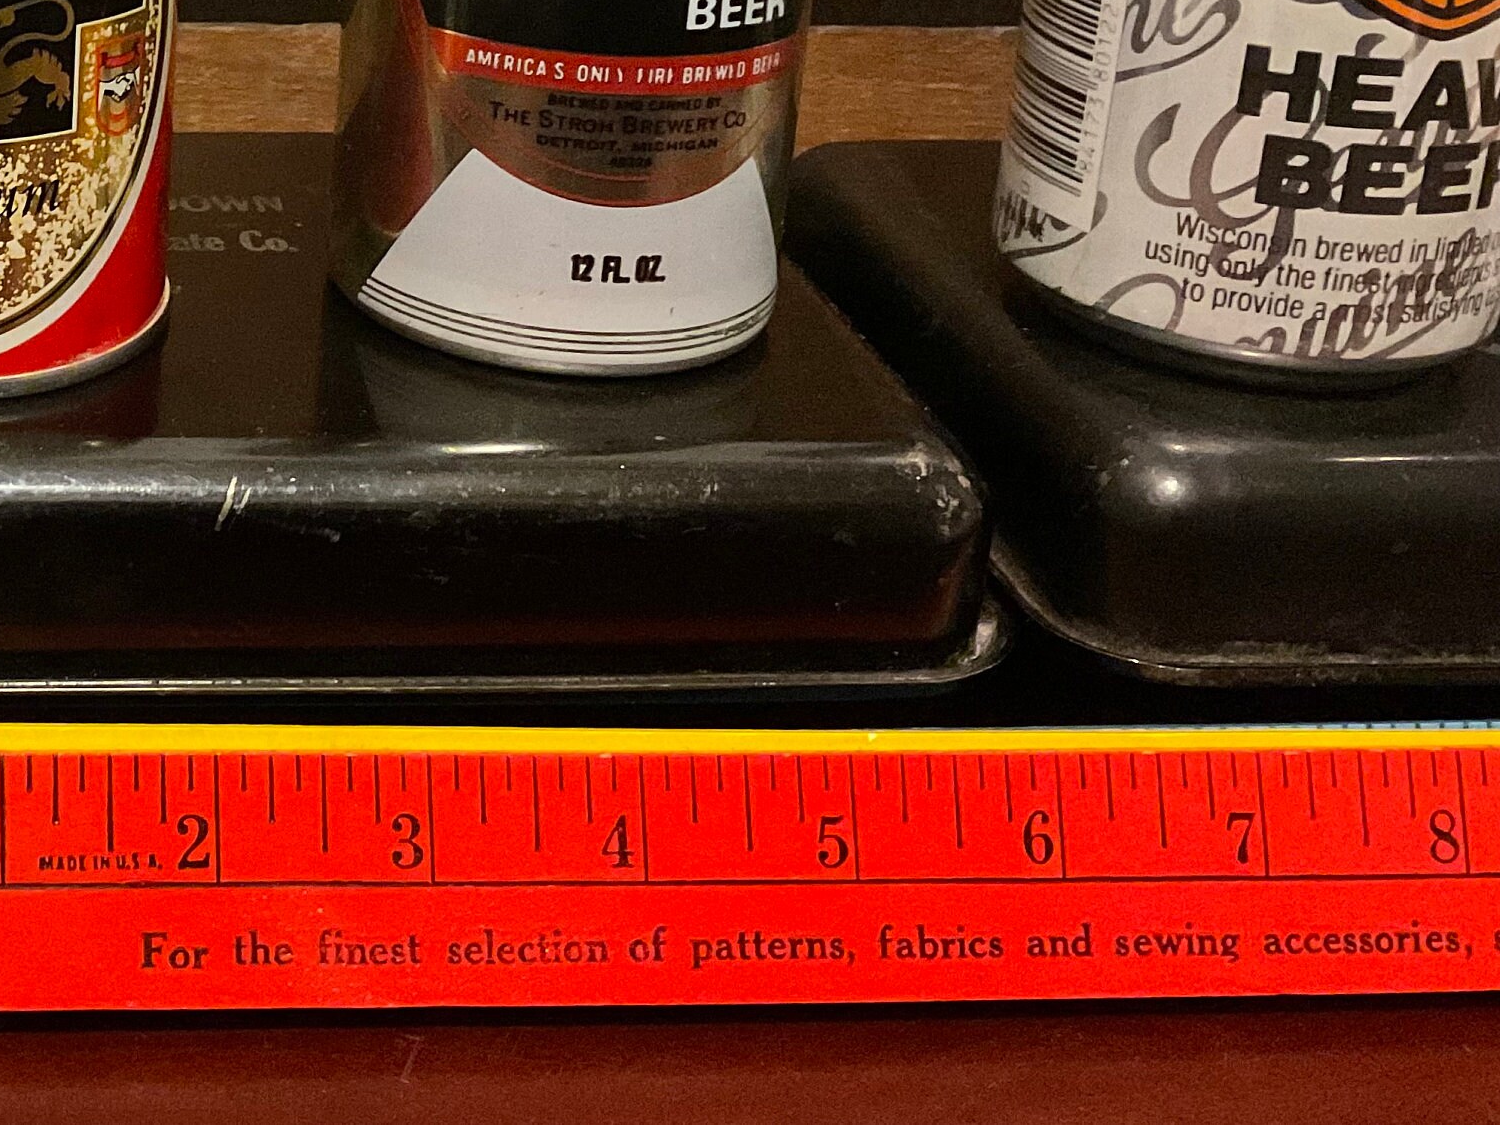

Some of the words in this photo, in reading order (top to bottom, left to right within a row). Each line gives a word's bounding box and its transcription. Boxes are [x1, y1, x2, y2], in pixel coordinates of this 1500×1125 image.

[466, 48, 565, 80] AMERICAS
[488, 101, 531, 127] THE
[239, 230, 300, 252] Co.
[1176, 211, 1307, 258] Wisconn
[1315, 235, 1404, 263] brewed
[1409, 238, 1429, 263] in
[571, 254, 595, 282] 12
[1145, 240, 1210, 277] using
[1276, 263, 1316, 290] the
[1322, 266, 1392, 294] finest
[1181, 277, 1205, 303] to
[1211, 288, 1305, 319] provide
[1313, 301, 1327, 321] a
[176, 813, 211, 870] 2
[391, 812, 424, 869] 3
[601, 813, 635, 869] 4
[816, 814, 849, 868] 5
[1022, 809, 1054, 865] 6
[1225, 811, 1256, 865] 7
[1429, 808, 1460, 864] 8
[140, 931, 208, 971] For
[234, 931, 294, 967] the
[316, 929, 422, 967] finest
[446, 928, 610, 966] selection
[629, 926, 669, 963] of
[691, 928, 856, 969] patterns,
[878, 922, 1004, 961] fabrics
[1027, 922, 1092, 960] and
[1114, 920, 1241, 963] sewing
[1264, 919, 1473, 961] accessories,
